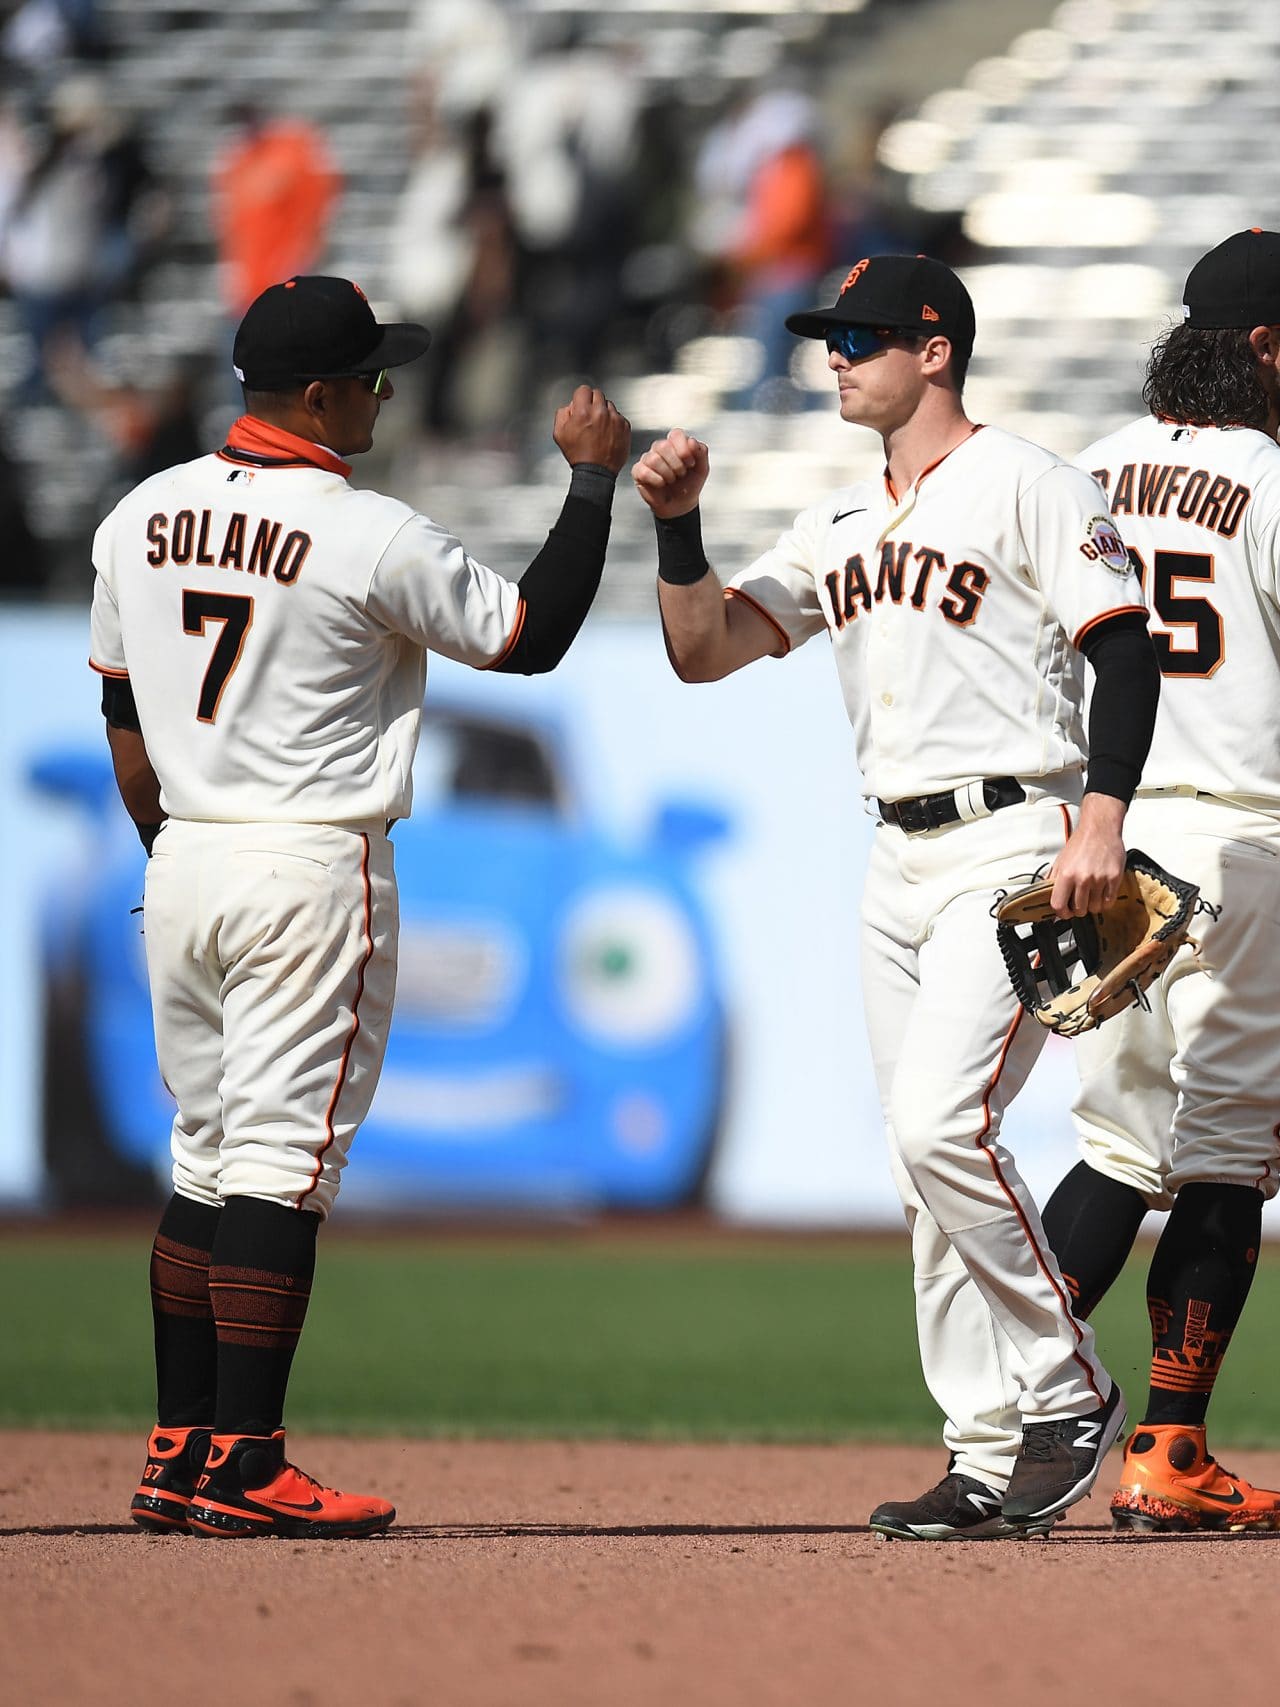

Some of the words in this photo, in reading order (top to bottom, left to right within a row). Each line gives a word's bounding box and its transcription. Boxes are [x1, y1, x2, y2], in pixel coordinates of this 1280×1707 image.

[1091, 463, 1250, 540] AWFORD
[147, 509, 312, 586] SOLANO
[825, 541, 991, 630] IANTS
[1080, 535, 1128, 561] GIANT
[1124, 546, 1225, 679] 5
[182, 588, 254, 724] 7
